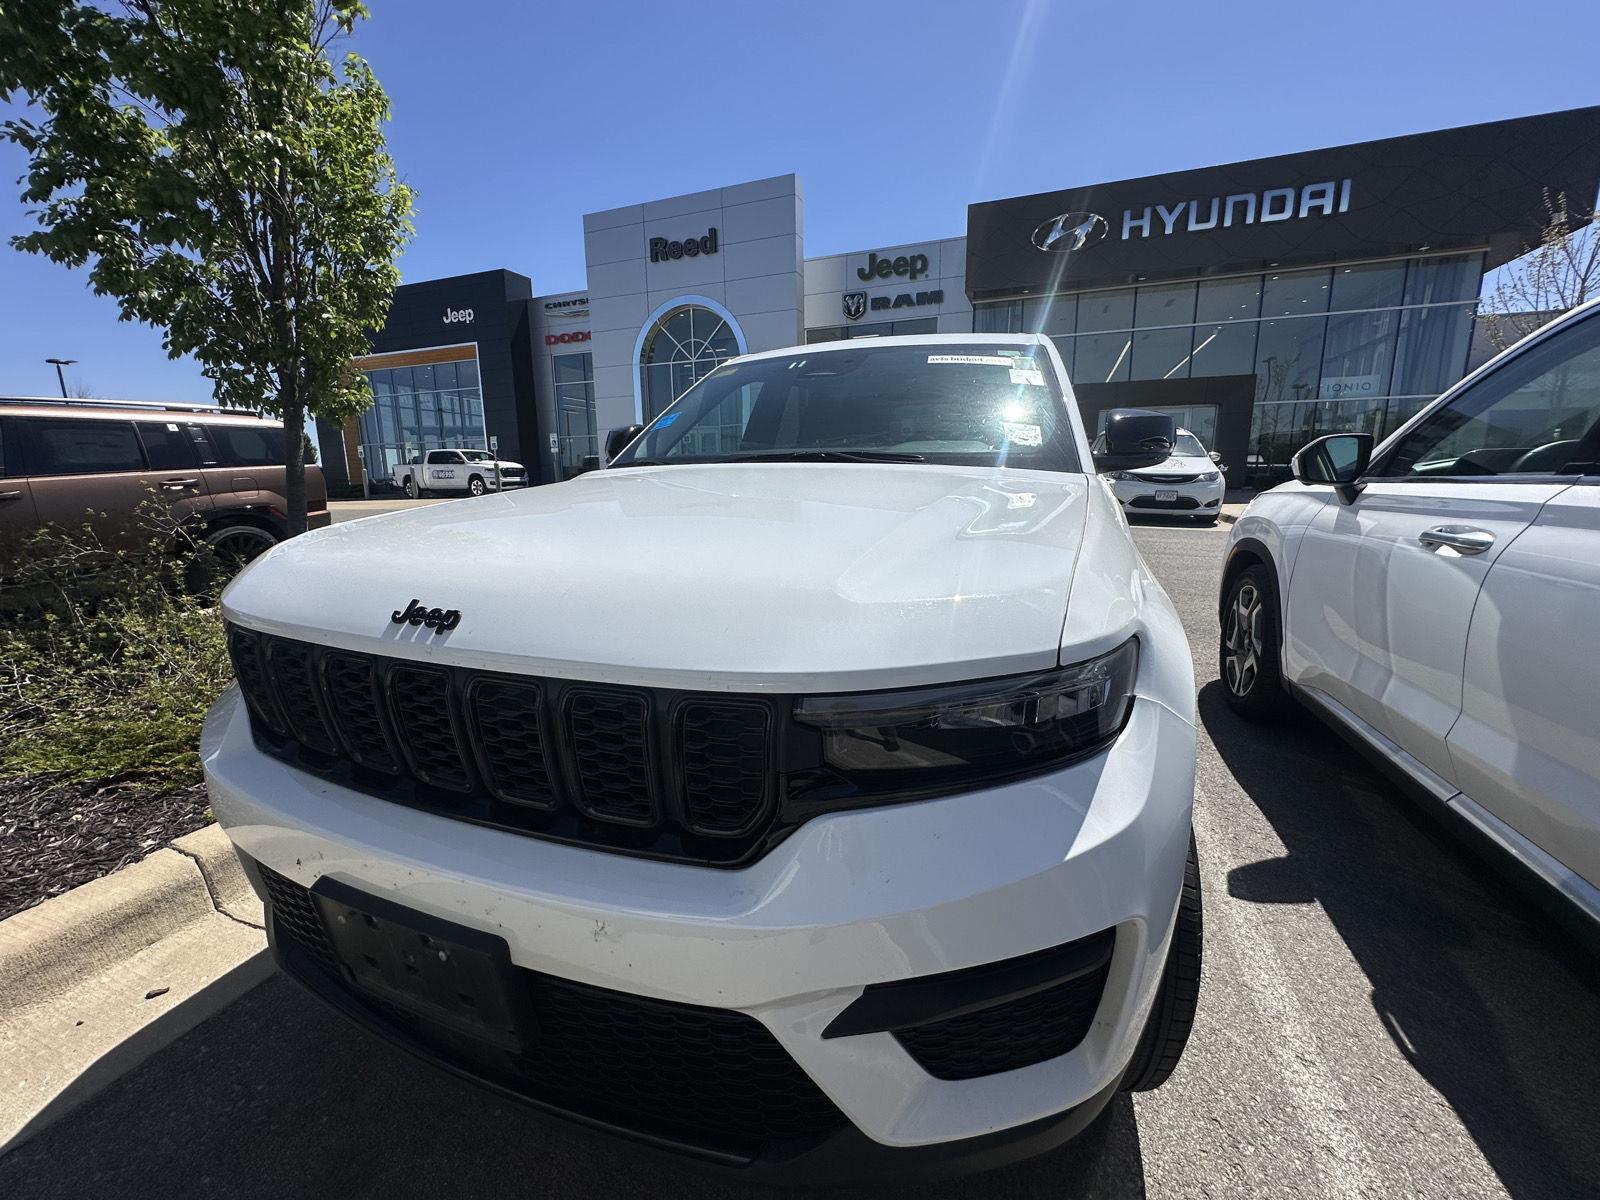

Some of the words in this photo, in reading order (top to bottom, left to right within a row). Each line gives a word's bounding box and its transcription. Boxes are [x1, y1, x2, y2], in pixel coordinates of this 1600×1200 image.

[1121, 179, 1352, 241] HYUNDAI
[649, 227, 718, 263] Reed
[857, 252, 928, 282] Jeep
[443, 308, 475, 324] Jeep
[871, 289, 944, 311] RAM
[391, 598, 463, 636] Jeep
